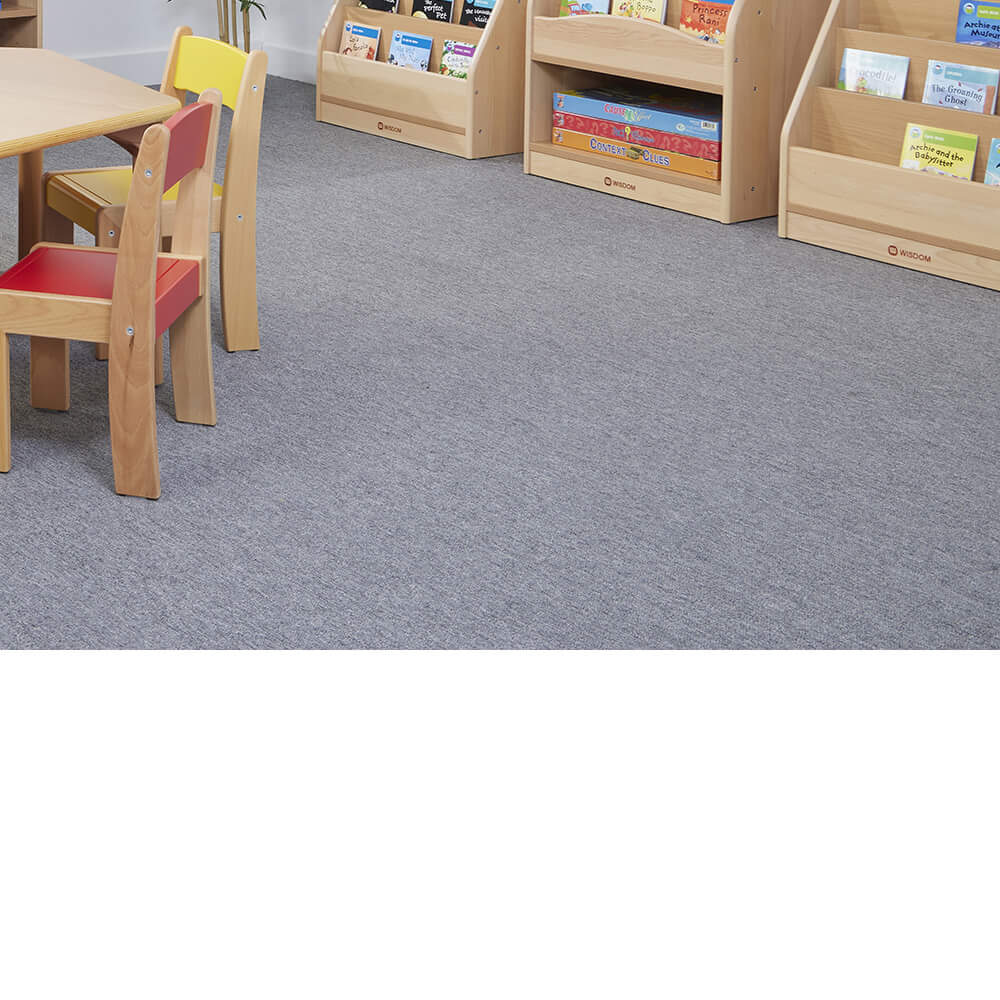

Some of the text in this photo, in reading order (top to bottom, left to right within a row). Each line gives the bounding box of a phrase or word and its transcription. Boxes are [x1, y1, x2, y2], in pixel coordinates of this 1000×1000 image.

[692, 3, 729, 17] Princess
[699, 14, 720, 27] Rani
[964, 20, 990, 30] Archie
[932, 83, 983, 102] The Groaning
[944, 95, 968, 106] Ghost
[590, 137, 627, 156] CONTEXT
[642, 149, 670, 166] CLUES
[911, 144, 964, 162] Archie and the
[914, 151, 954, 168] Babysitter
[612, 180, 637, 191] WISDOM
[899, 249, 932, 263] WISDOM
